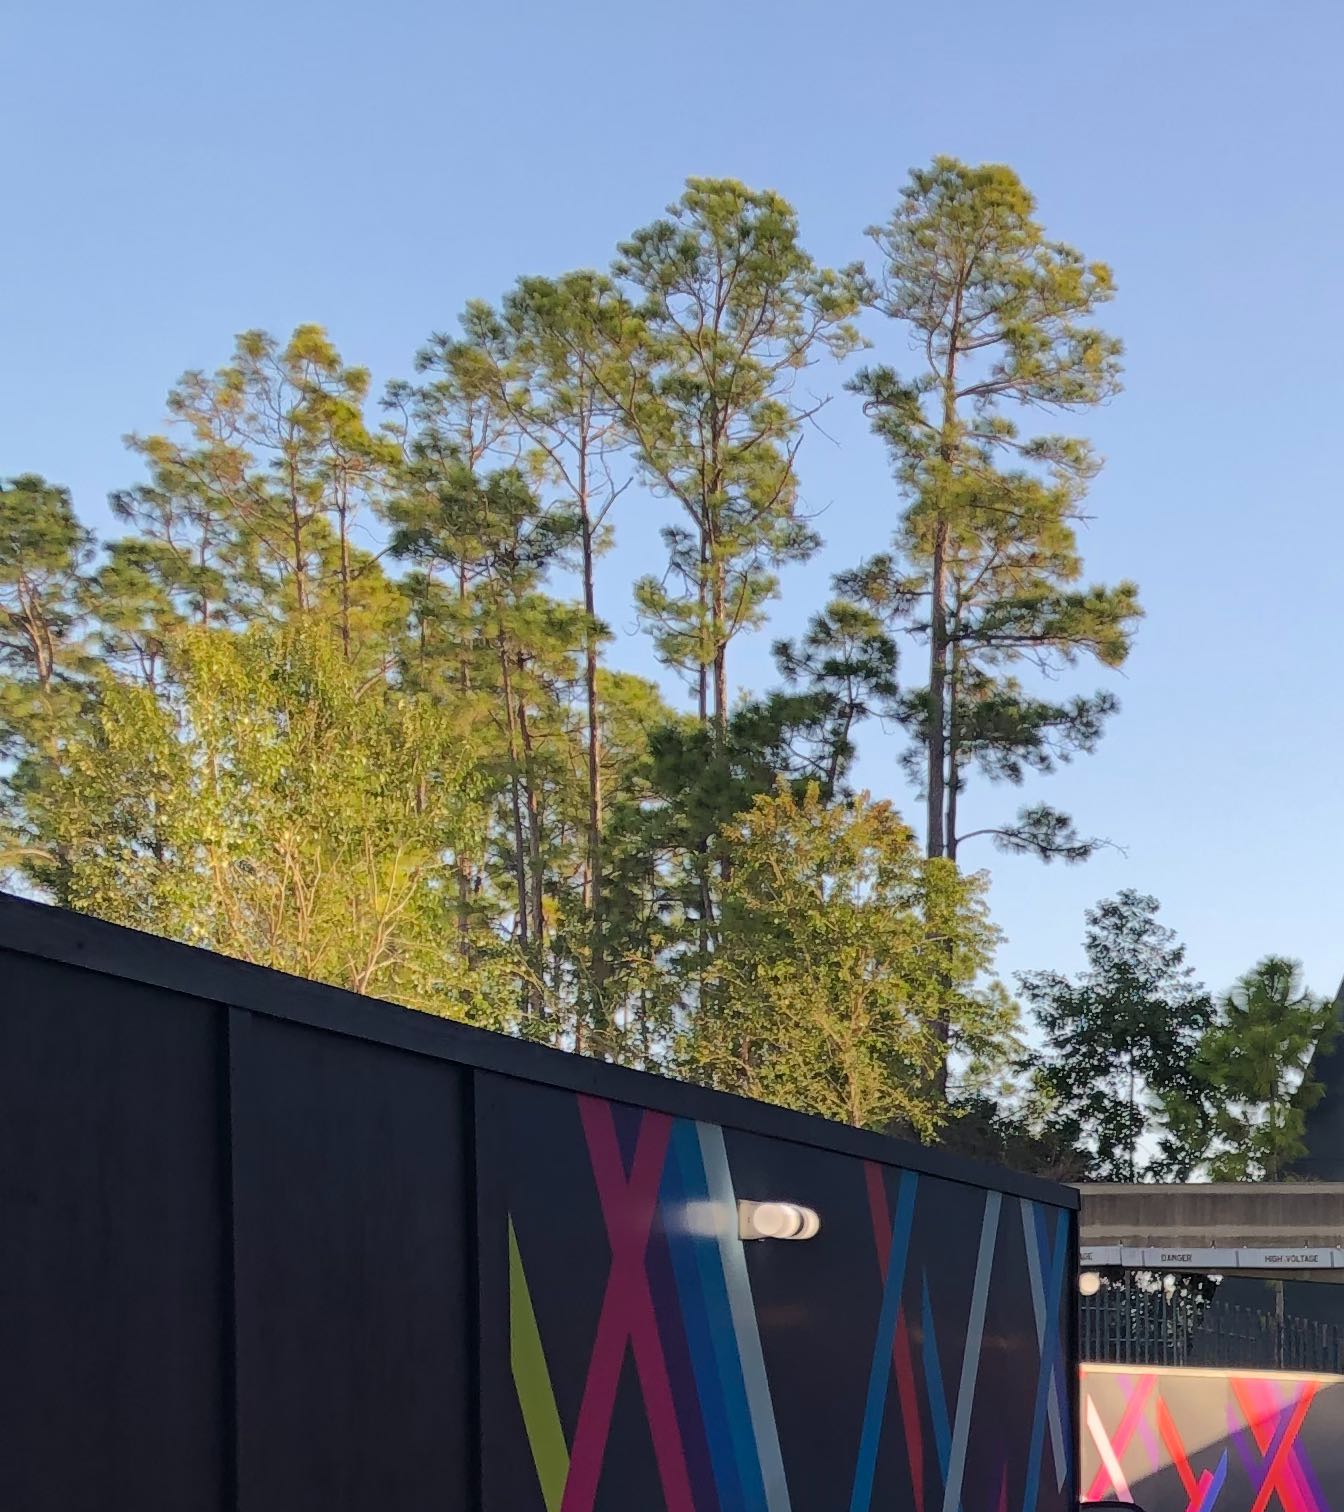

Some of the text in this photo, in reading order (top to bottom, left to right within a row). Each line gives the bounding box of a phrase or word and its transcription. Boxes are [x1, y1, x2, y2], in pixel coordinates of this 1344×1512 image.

[1160, 1253, 1193, 1263] DANGER
[1264, 1254, 1319, 1263] HIGH VOLTAGE
